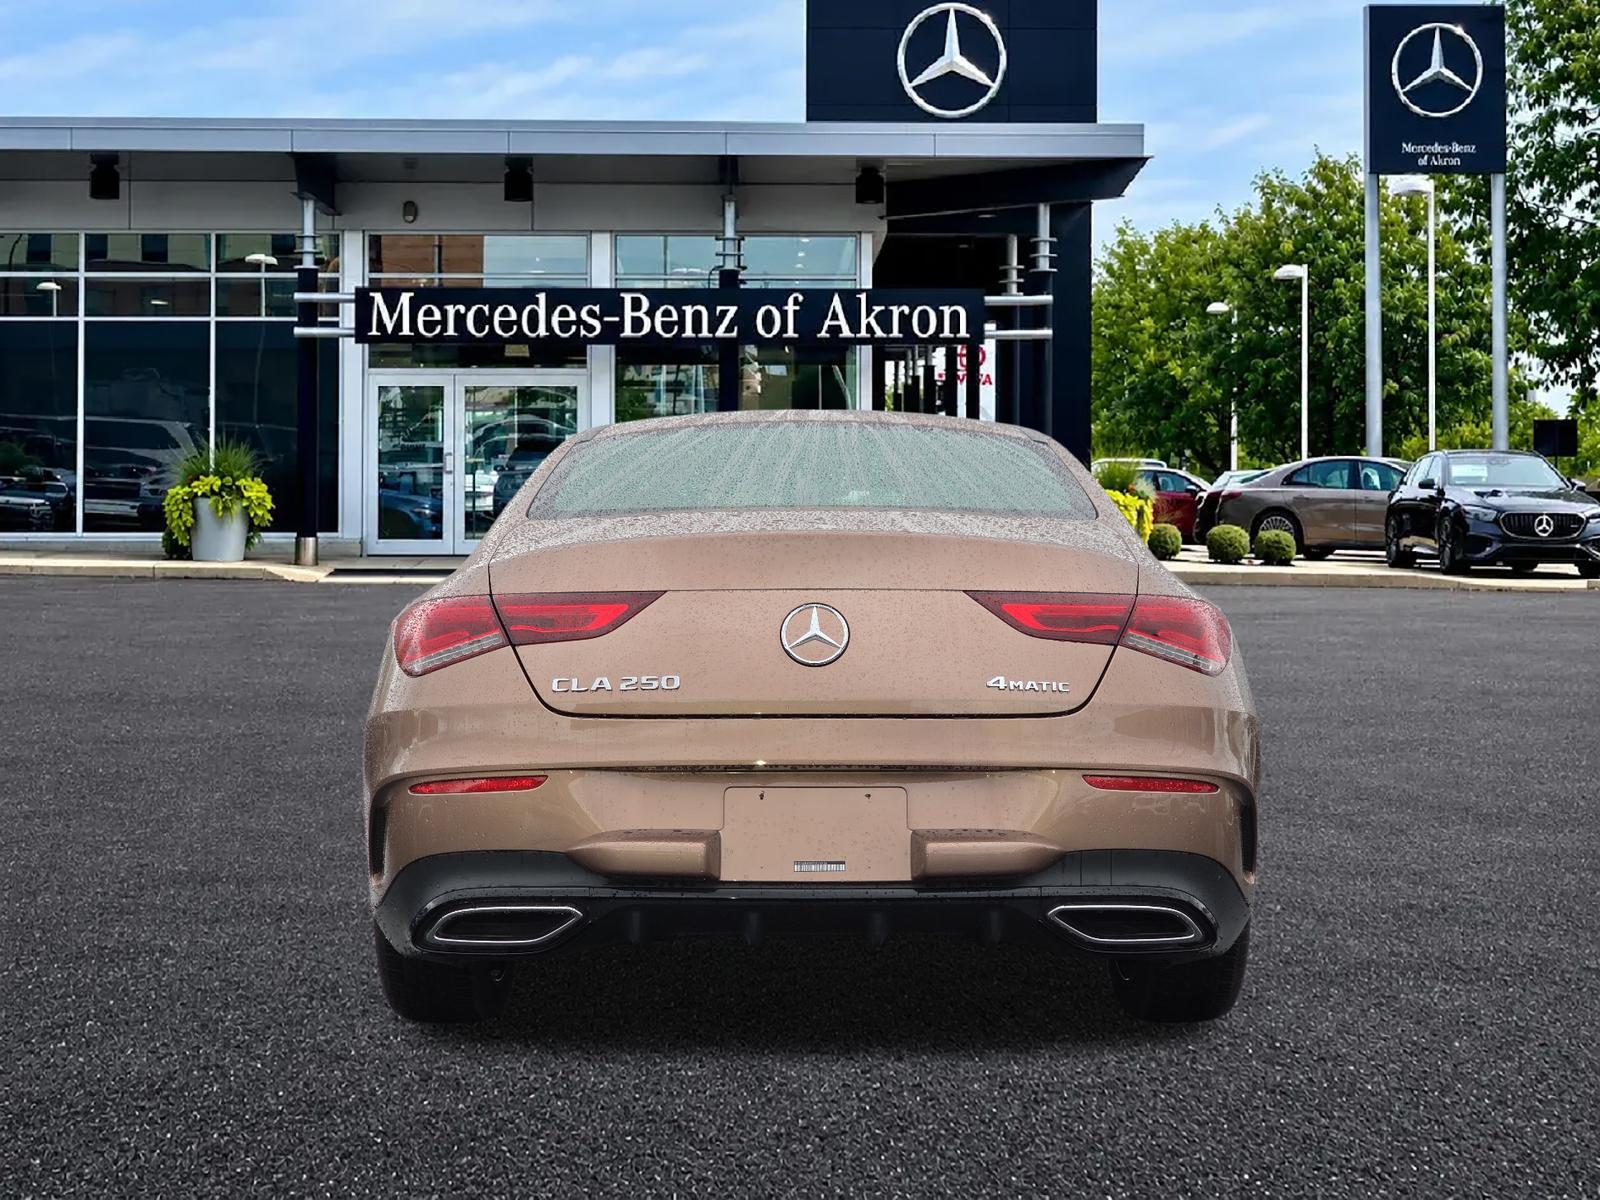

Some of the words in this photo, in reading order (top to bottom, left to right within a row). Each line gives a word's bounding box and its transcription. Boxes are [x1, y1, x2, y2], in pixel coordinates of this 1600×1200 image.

[1401, 141, 1477, 153] Mercedes-Benz
[1417, 154, 1429, 166] of
[1430, 154, 1461, 166] Akron
[367, 292, 738, 338] Mercedes-Benz
[755, 292, 804, 338] of
[816, 292, 970, 338] Akron
[551, 677, 613, 692] CLA
[619, 675, 681, 691] 250
[986, 676, 1070, 692] 4MATIC
